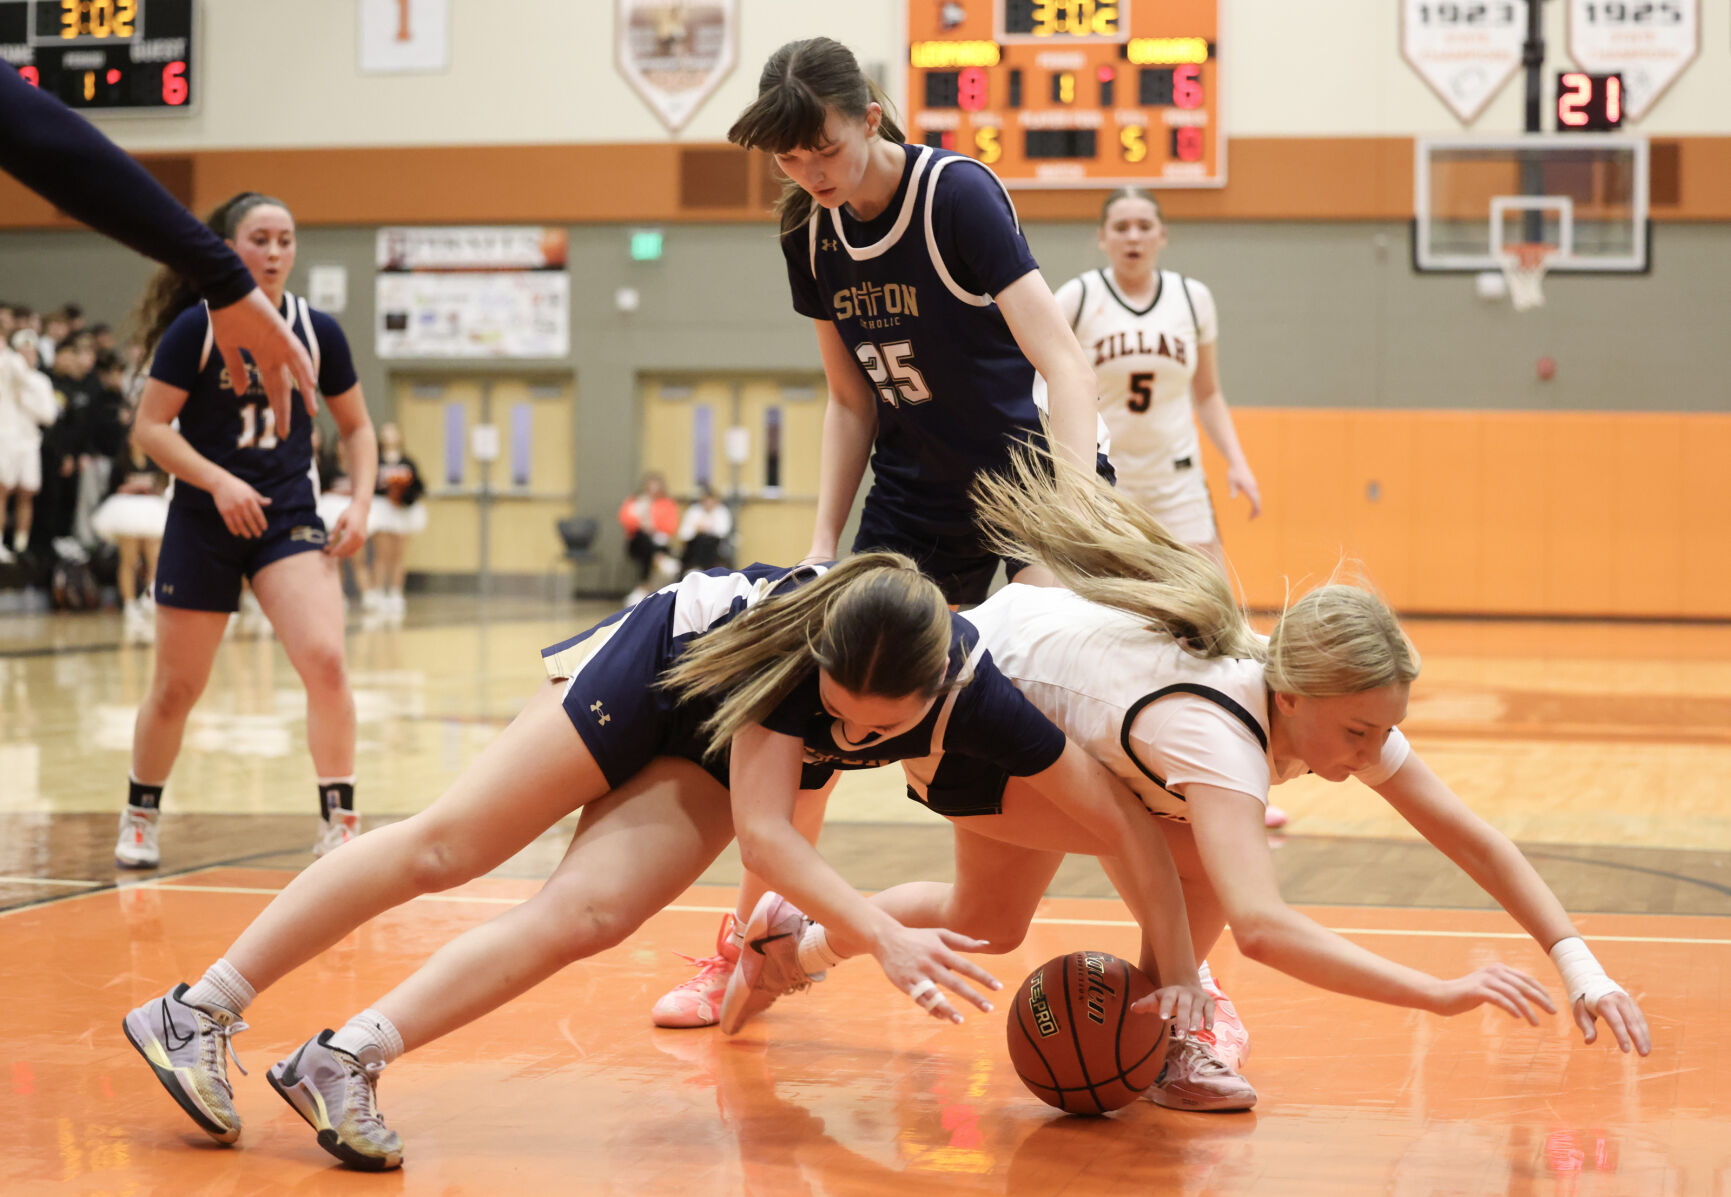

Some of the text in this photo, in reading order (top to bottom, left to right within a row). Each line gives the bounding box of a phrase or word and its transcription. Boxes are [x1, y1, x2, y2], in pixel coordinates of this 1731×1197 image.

[60, 0, 138, 39] 3:02
[1031, 0, 1119, 36] 3:02
[1419, 1, 1514, 23] 1923
[1585, 1, 1682, 23] 1925
[162, 61, 188, 105] 6
[958, 67, 988, 111] 8
[1173, 64, 1203, 109] 6
[1558, 73, 1620, 126] 21
[1094, 331, 1187, 366] ZILLAH
[855, 339, 932, 408] 25
[1127, 372, 1155, 414] 5
[236, 404, 278, 449] 11
[1033, 1001, 1056, 1034] PRO
